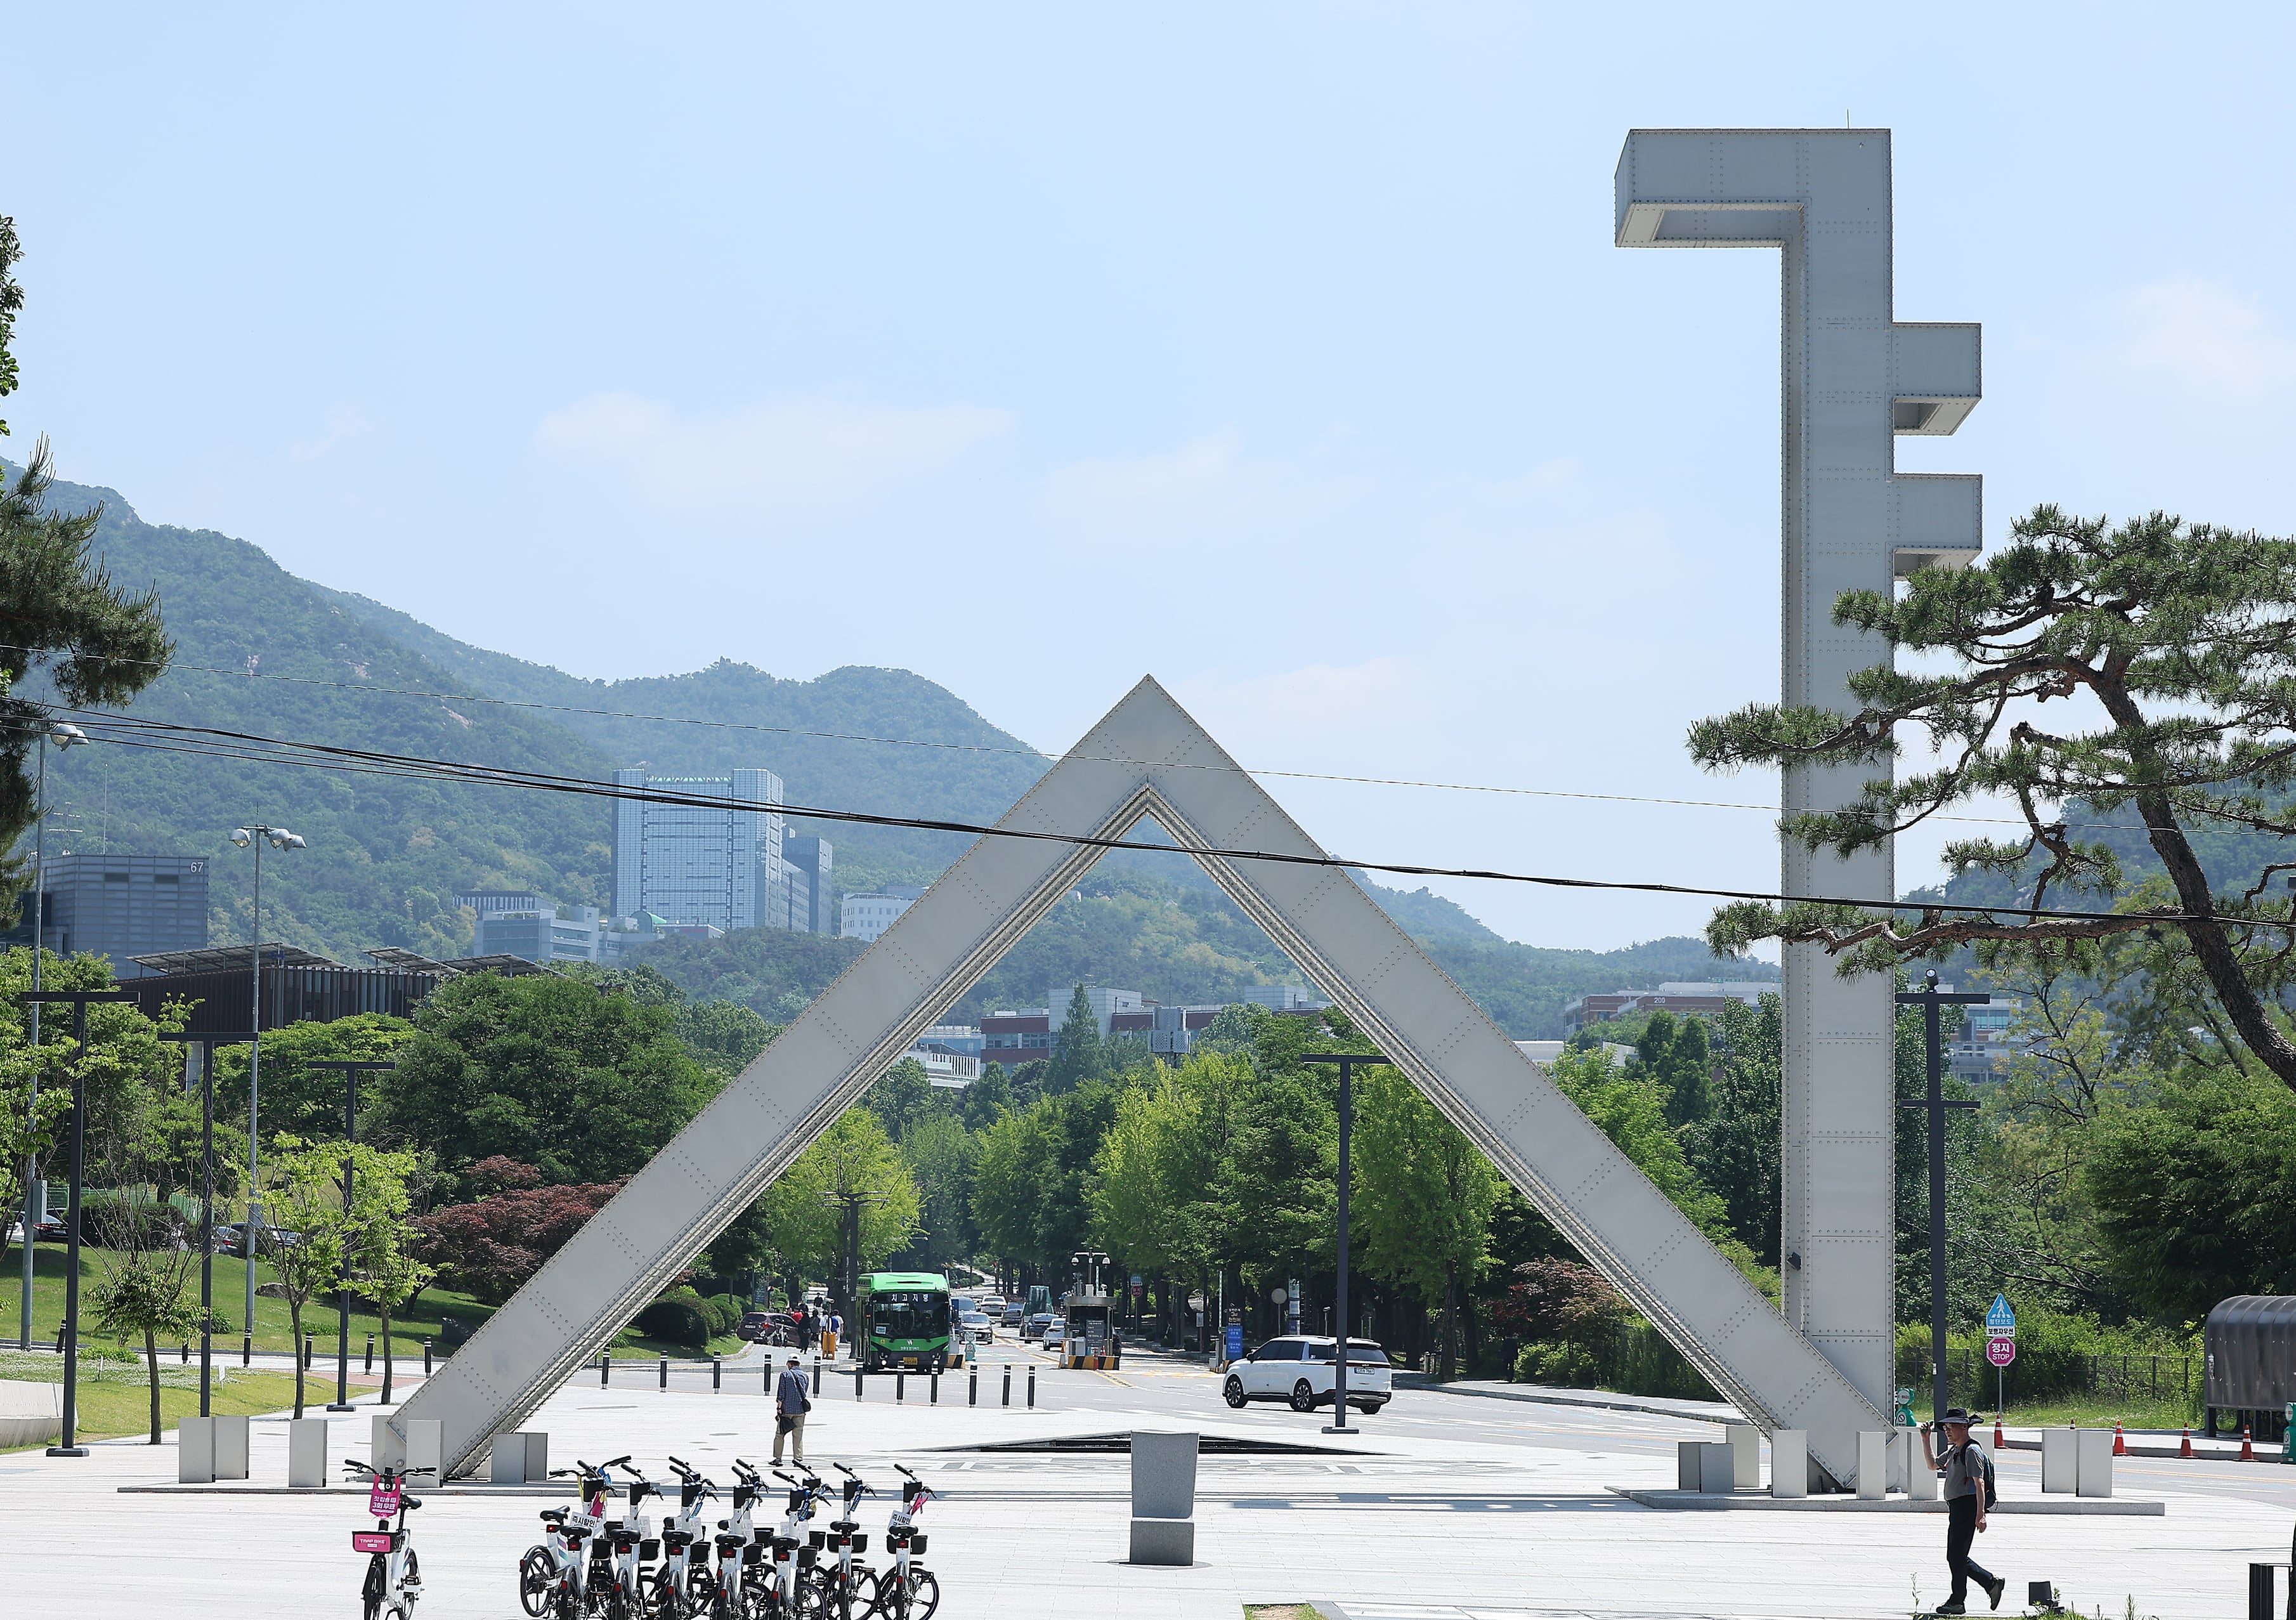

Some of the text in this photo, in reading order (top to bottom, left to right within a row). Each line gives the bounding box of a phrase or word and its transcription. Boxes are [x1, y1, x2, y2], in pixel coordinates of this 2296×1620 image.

[190, 862, 204, 873] 67
[1992, 1343, 2010, 1353] 정지
[572, 1515, 596, 1527] 즉시할인
